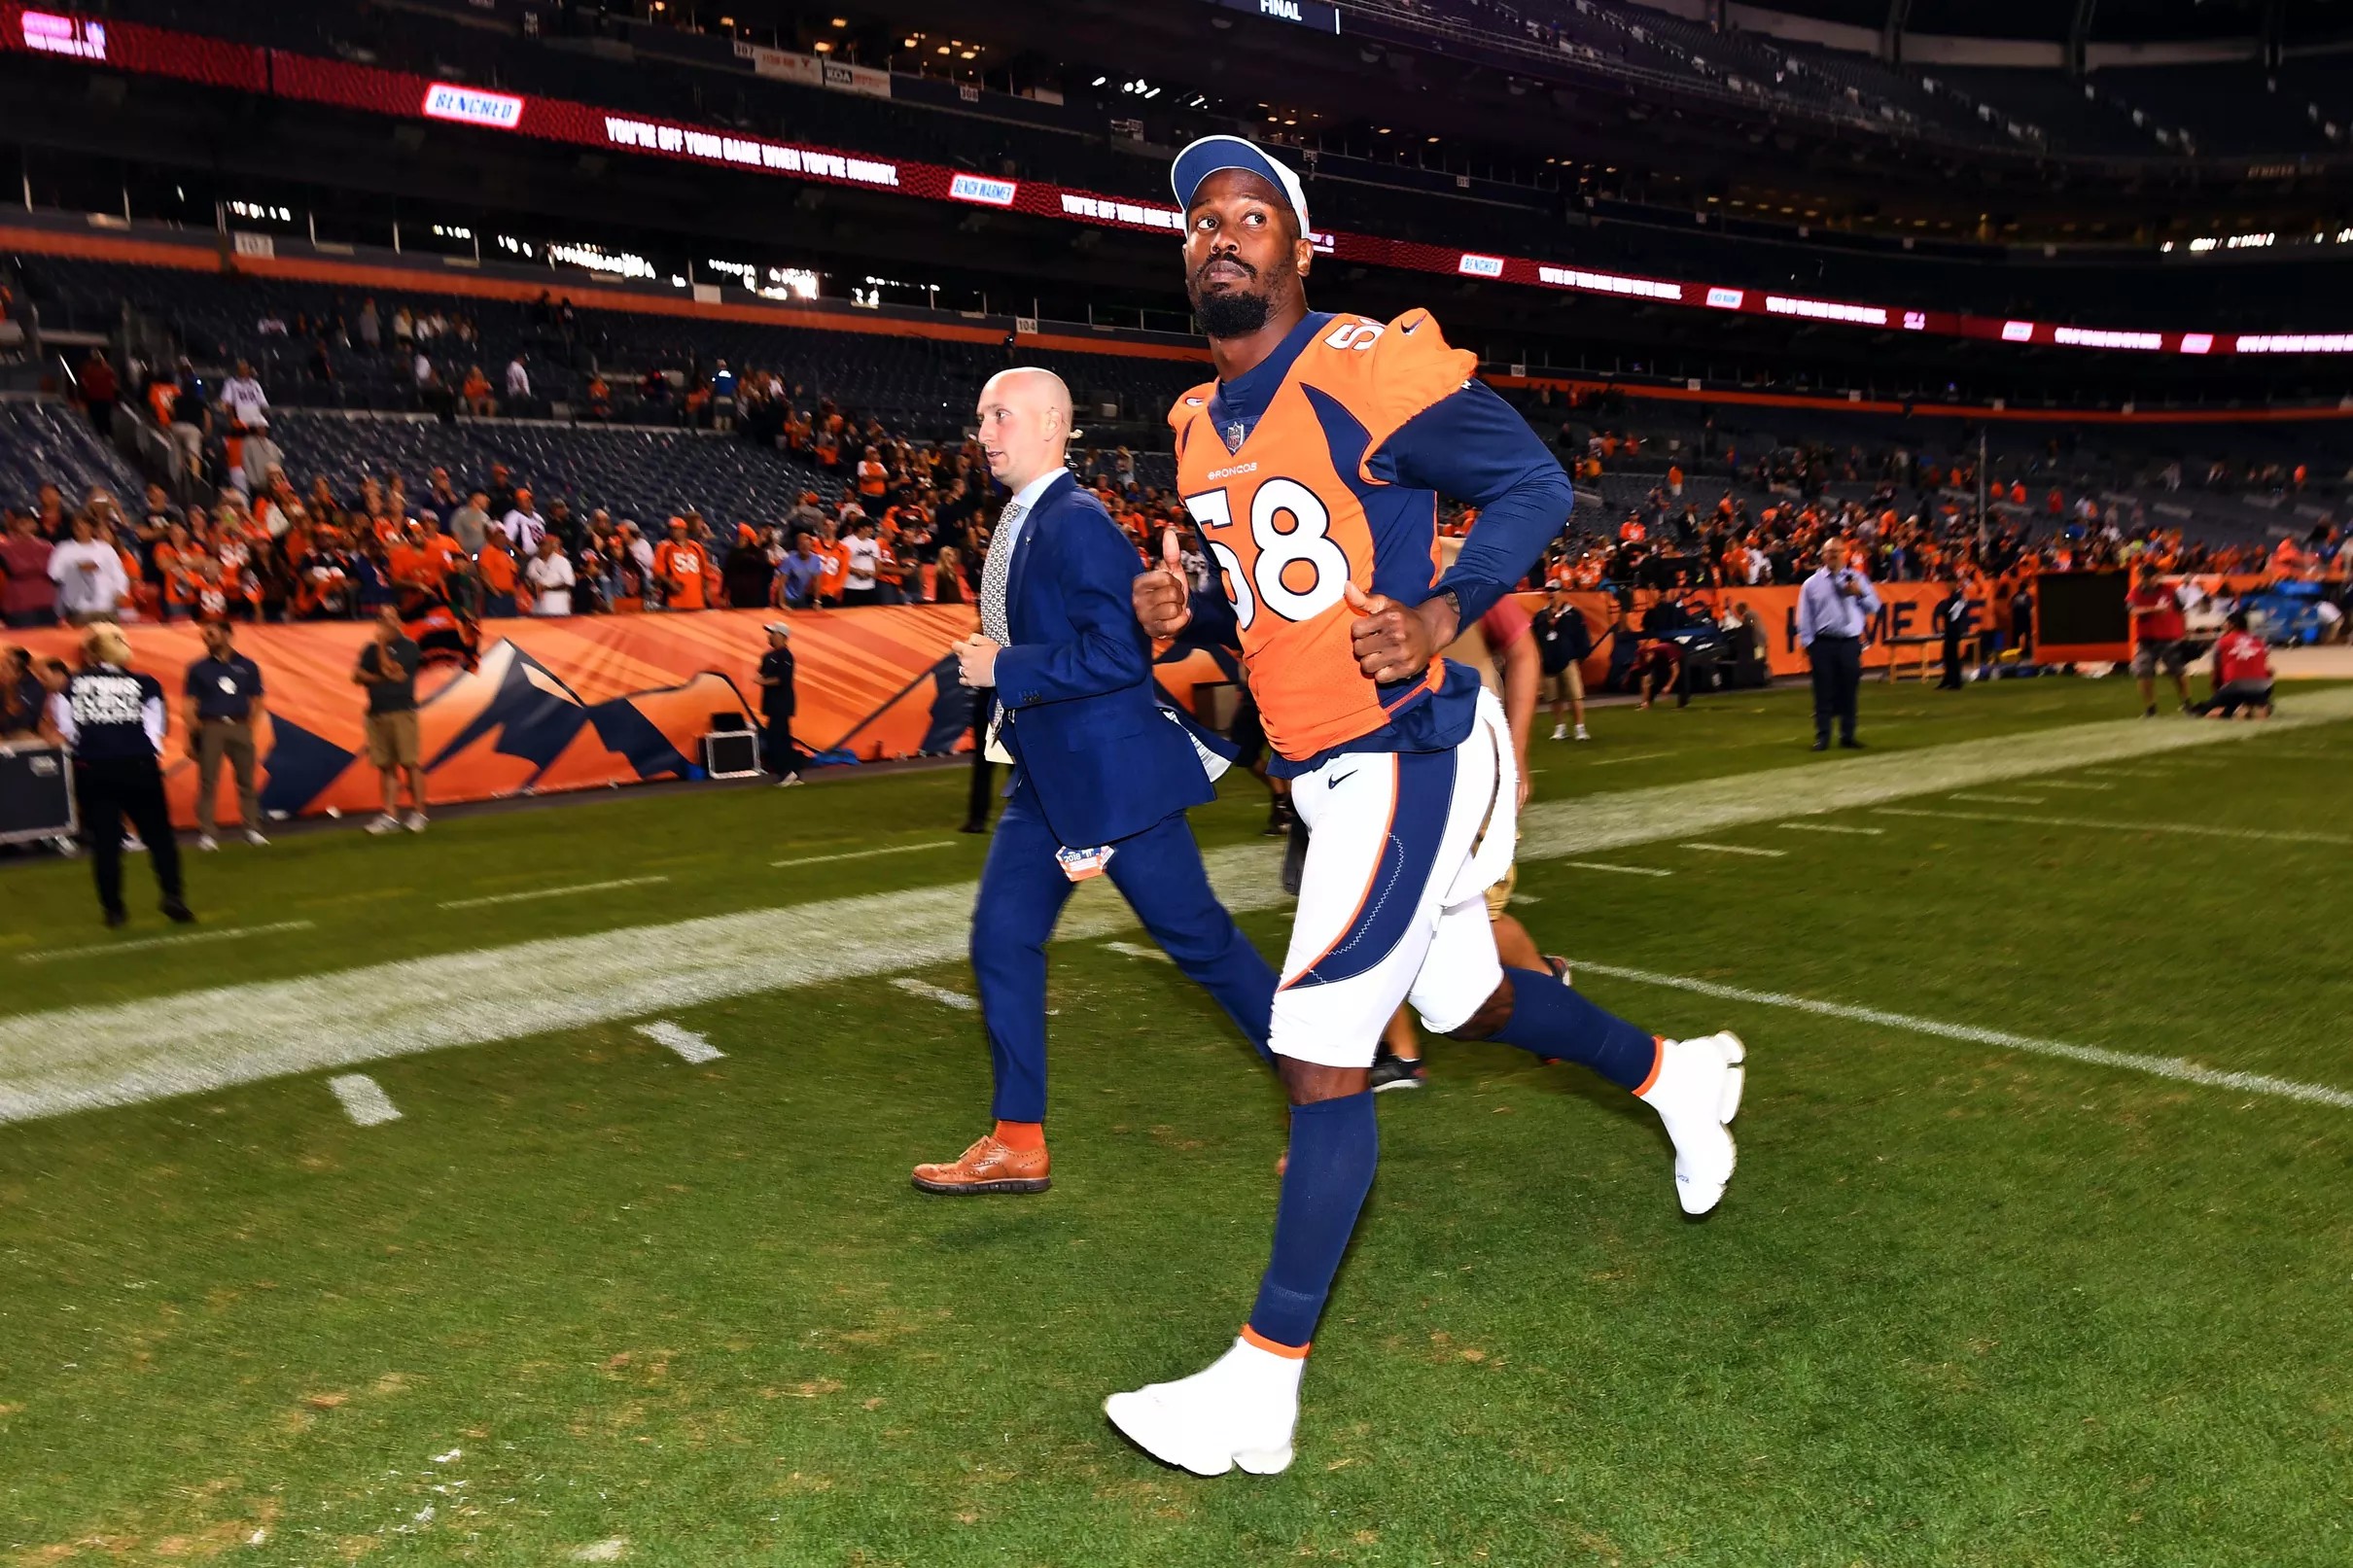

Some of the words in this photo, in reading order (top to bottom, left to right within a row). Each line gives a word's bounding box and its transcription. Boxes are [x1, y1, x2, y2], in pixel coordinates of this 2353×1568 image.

[1260, 0, 1303, 20] FINAL
[605, 117, 656, 148] YOU'RE
[657, 125, 683, 153] OFF
[684, 130, 722, 158] YOUR
[1018, 320, 1036, 331] 104
[1323, 318, 1386, 350] 5
[1208, 462, 1257, 480] BRONCOS
[1184, 475, 1351, 632] 58
[1063, 853, 1082, 863] 2018
